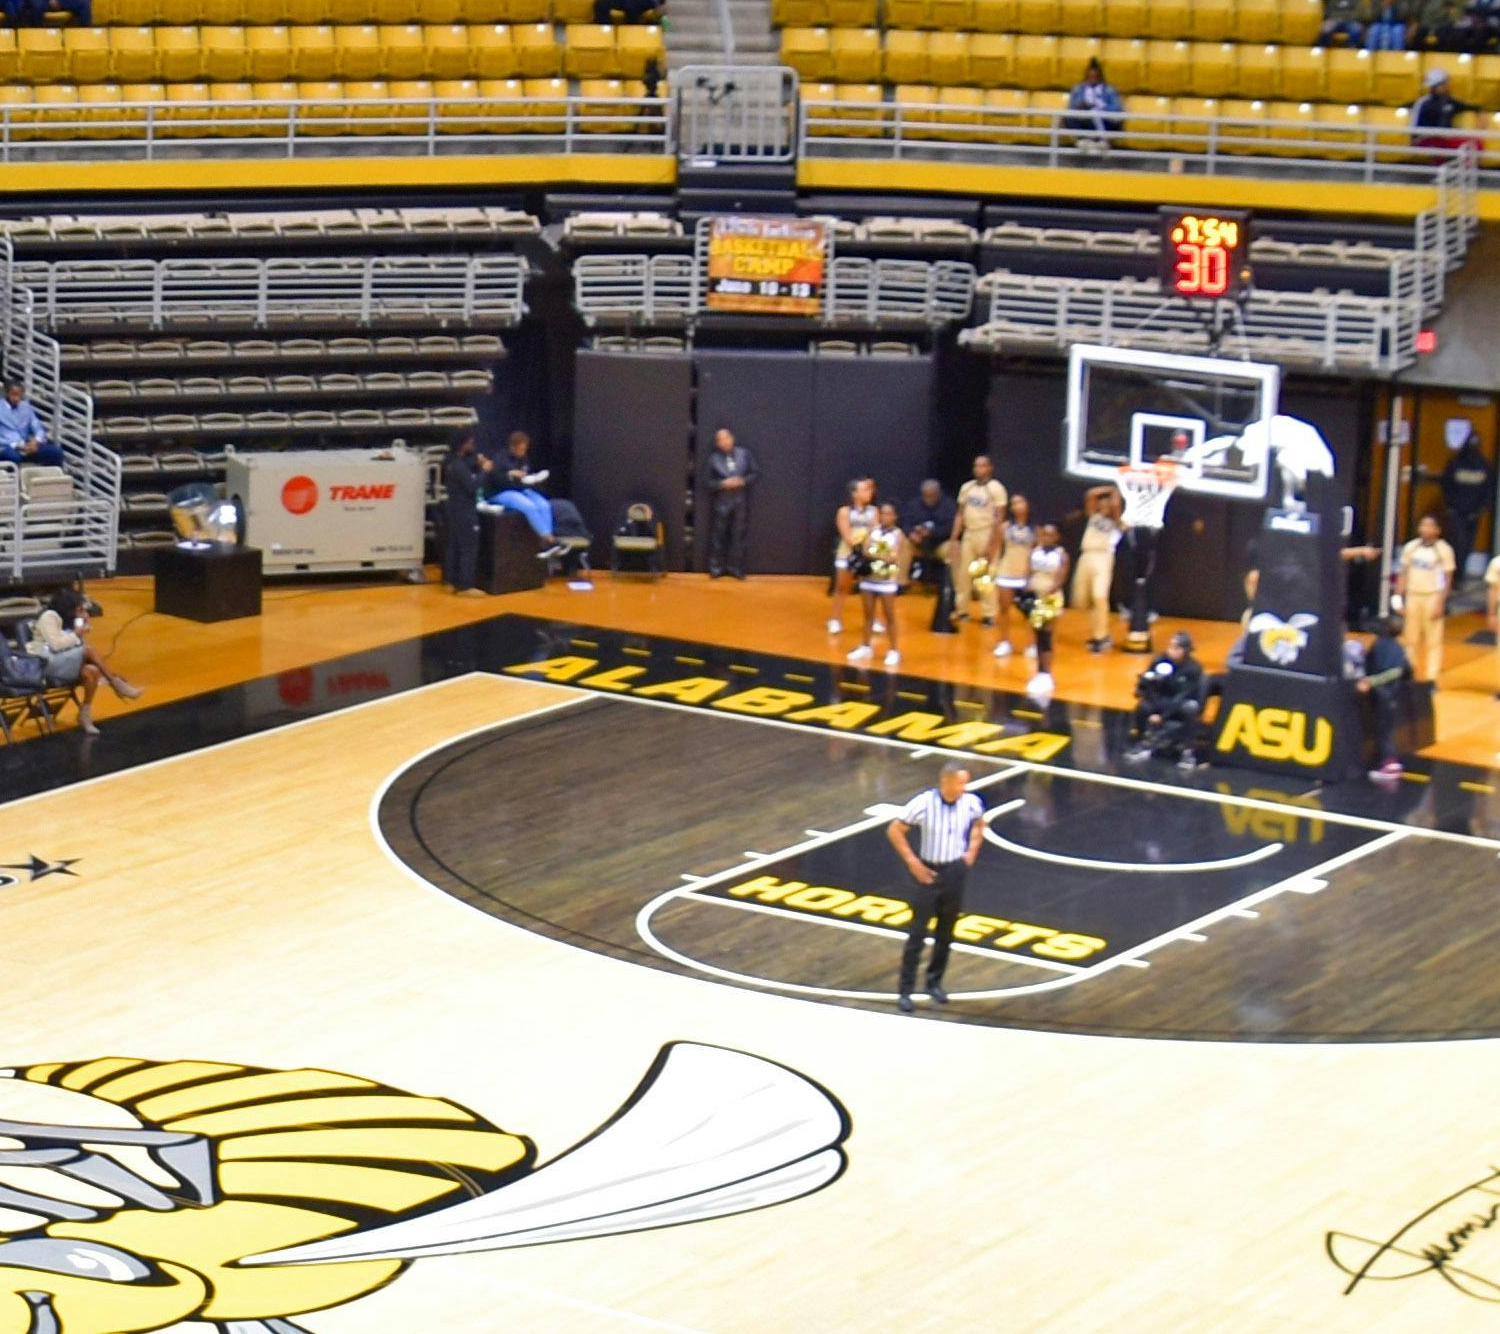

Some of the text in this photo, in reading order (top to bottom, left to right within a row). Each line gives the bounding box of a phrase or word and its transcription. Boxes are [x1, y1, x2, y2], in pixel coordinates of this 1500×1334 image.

[1176, 243, 1227, 293] 30
[328, 483, 397, 501] TRANE
[503, 655, 1072, 762] ALABAMA
[1216, 700, 1333, 766] ASU
[728, 874, 1108, 961] HORETS
